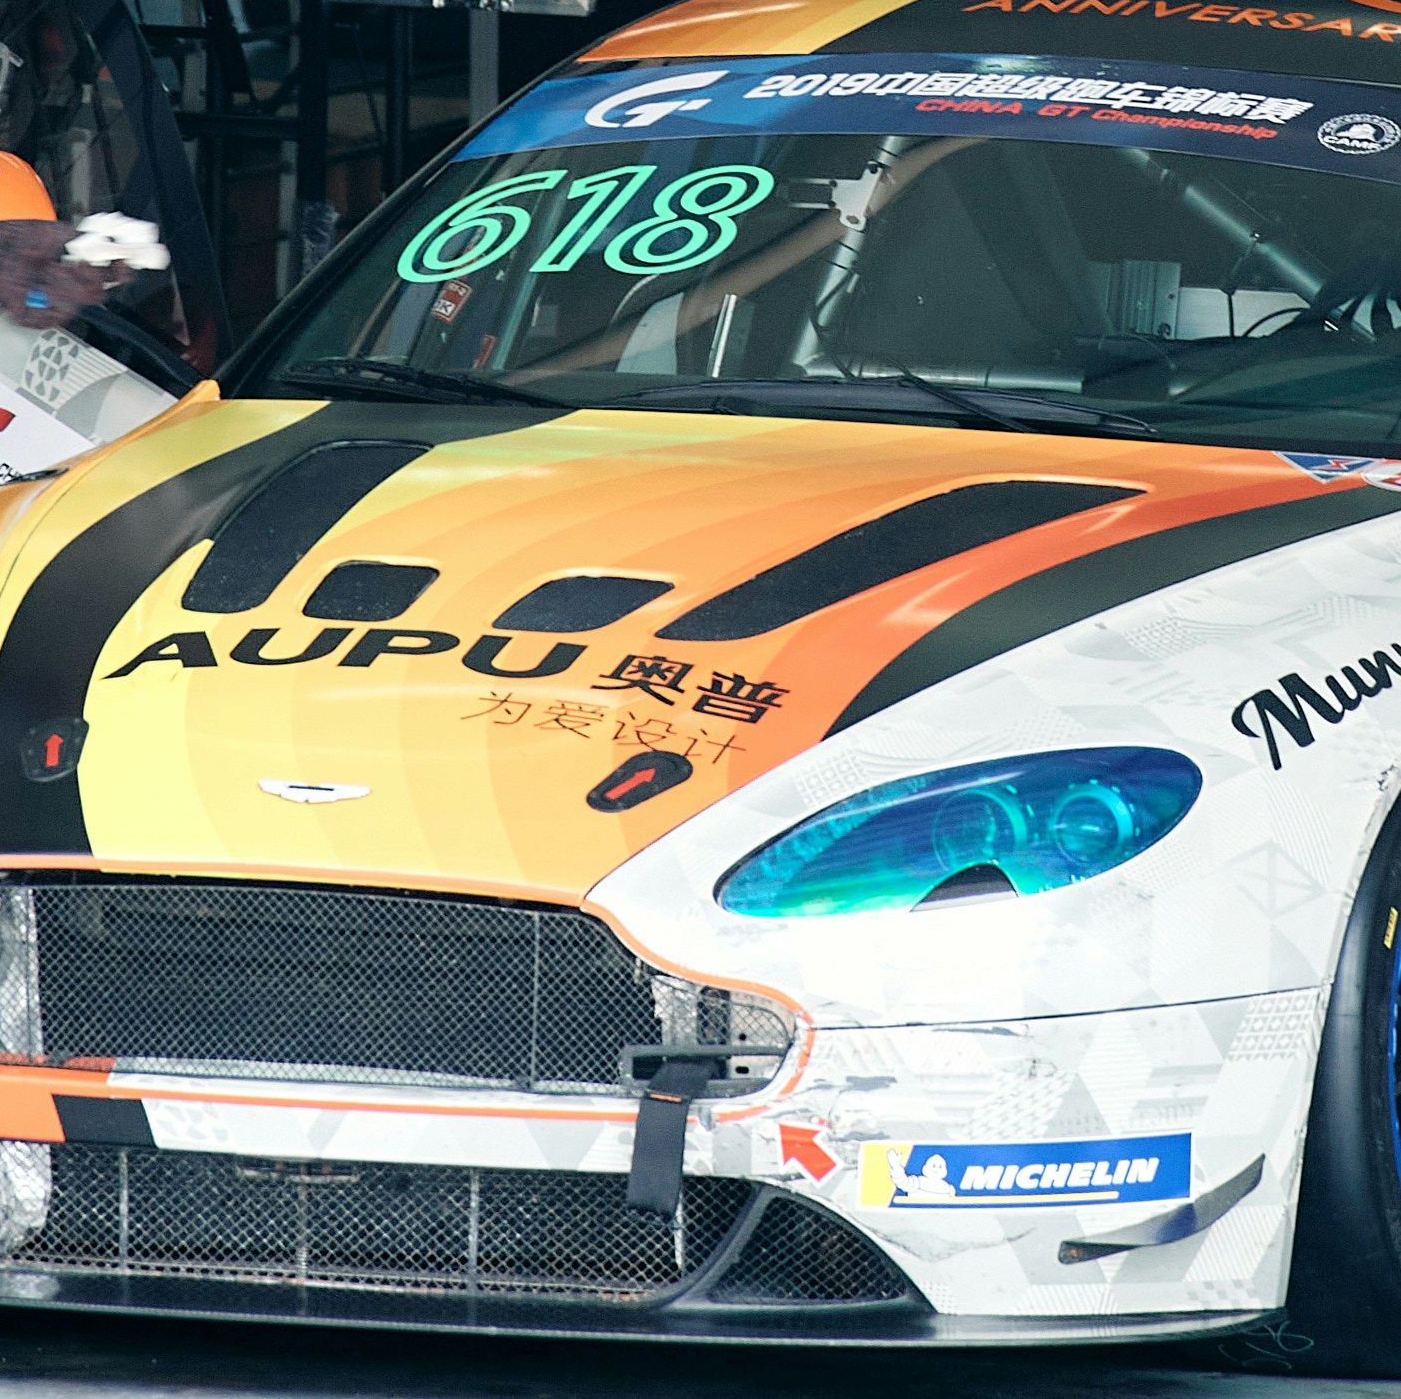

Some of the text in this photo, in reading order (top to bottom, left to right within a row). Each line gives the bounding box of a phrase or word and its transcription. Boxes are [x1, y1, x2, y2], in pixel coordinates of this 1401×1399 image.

[915, 99, 1279, 140] CHINA GT Championship
[397, 165, 775, 283] 618
[101, 627, 790, 725] AUPU 奥普
[460, 690, 747, 764] 为爱设计
[959, 1156, 1160, 1192] MICHELIN
